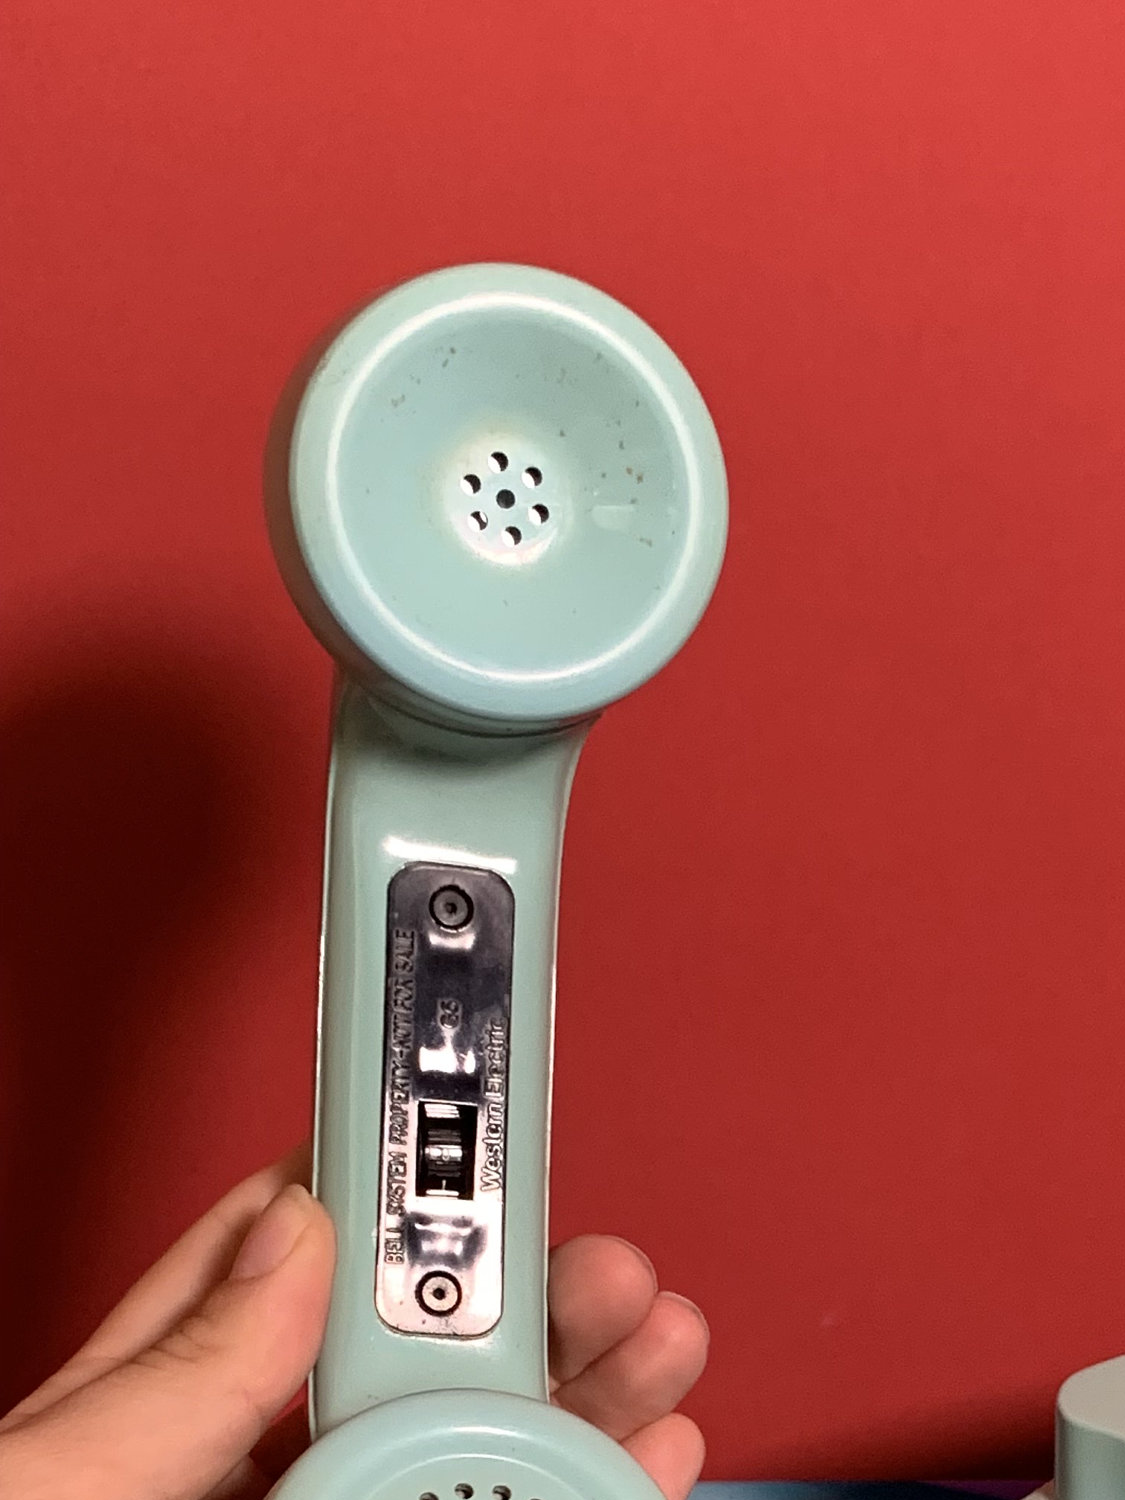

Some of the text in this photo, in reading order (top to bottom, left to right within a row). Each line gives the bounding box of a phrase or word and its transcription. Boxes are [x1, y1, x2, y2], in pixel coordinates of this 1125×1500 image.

[395, 929, 415, 973] SALE
[480, 1017, 506, 1192] Western Electric
[386, 1151, 408, 1216] SYSTEM
[384, 1227, 404, 1265] BELL
